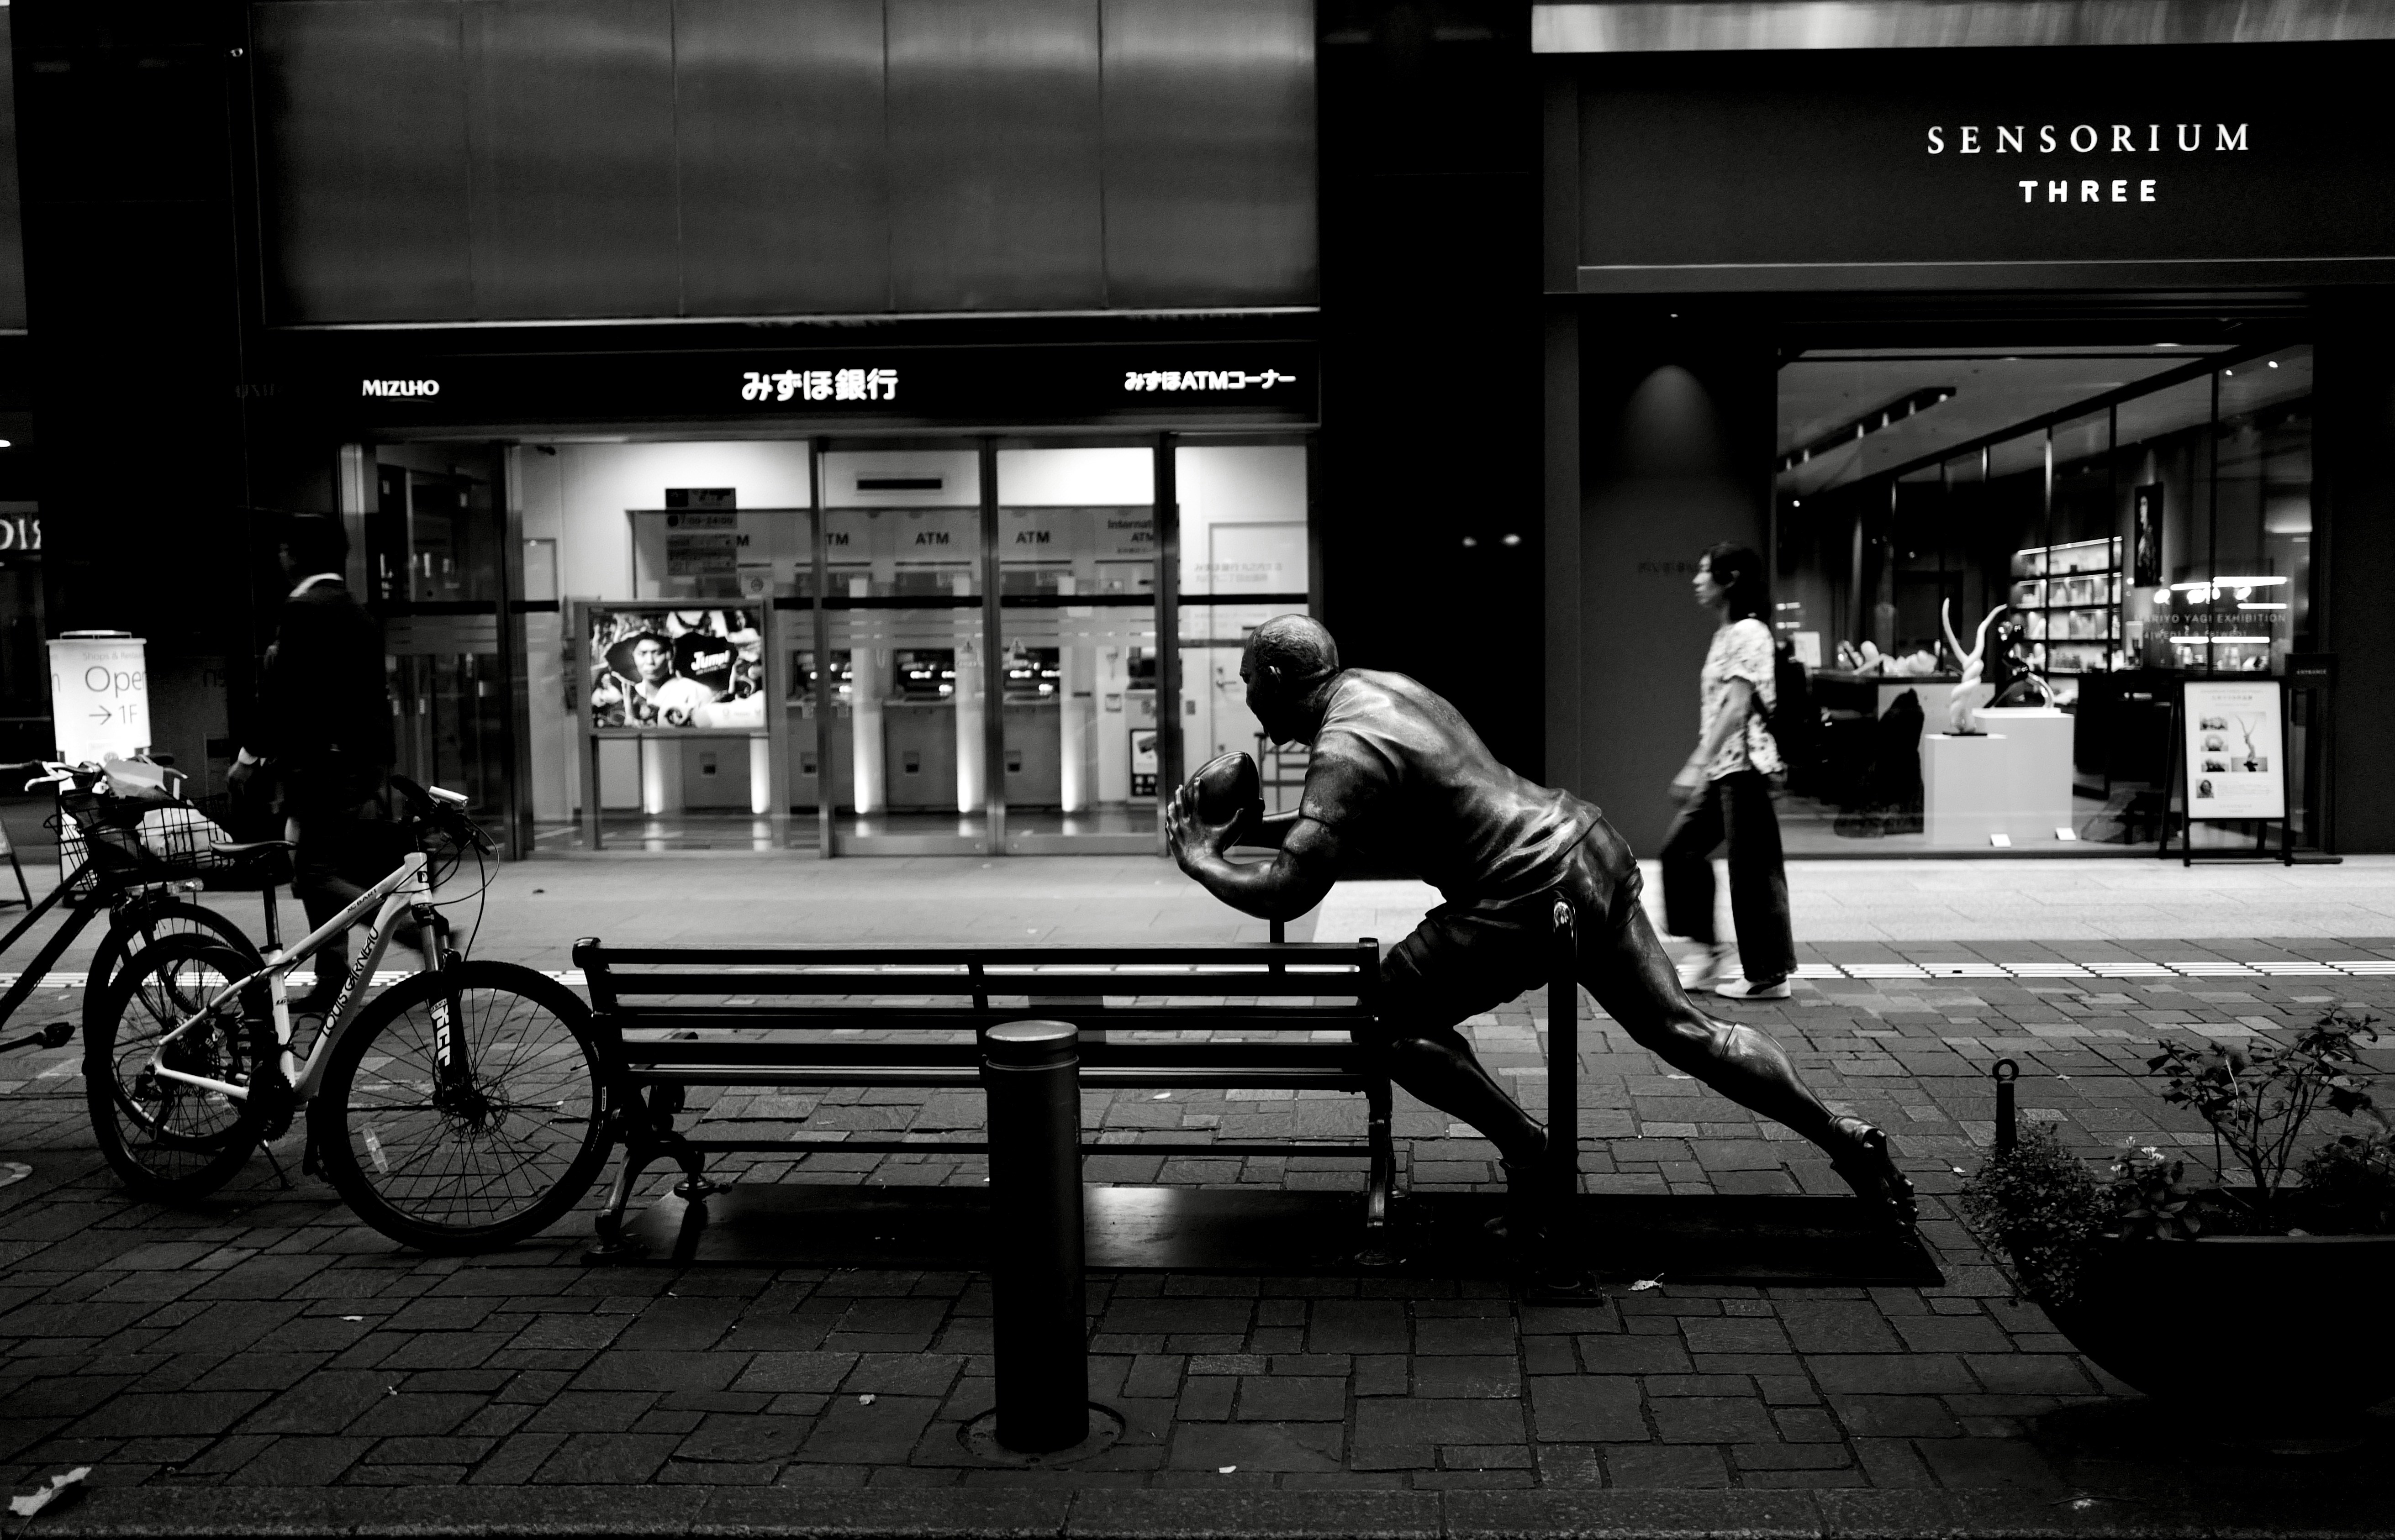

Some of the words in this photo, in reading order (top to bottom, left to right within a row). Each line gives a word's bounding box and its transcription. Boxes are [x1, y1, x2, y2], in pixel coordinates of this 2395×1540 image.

[1927, 123, 2249, 154] SENSORIUM
[2018, 179, 2157, 203] THREE
[741, 368, 899, 402] みずほ銀行
[1124, 368, 1296, 392] みずほATMコーナー
[825, 532, 849, 545] TM
[915, 531, 949, 545] ATM
[1016, 531, 1050, 544] ATM
[2185, 613, 2212, 623] YAGI
[2217, 613, 2286, 623] EXHIBITION
[118, 704, 137, 724] 1F
[321, 992, 348, 1039] LOUIS
[344, 925, 379, 992] GARNEAU
